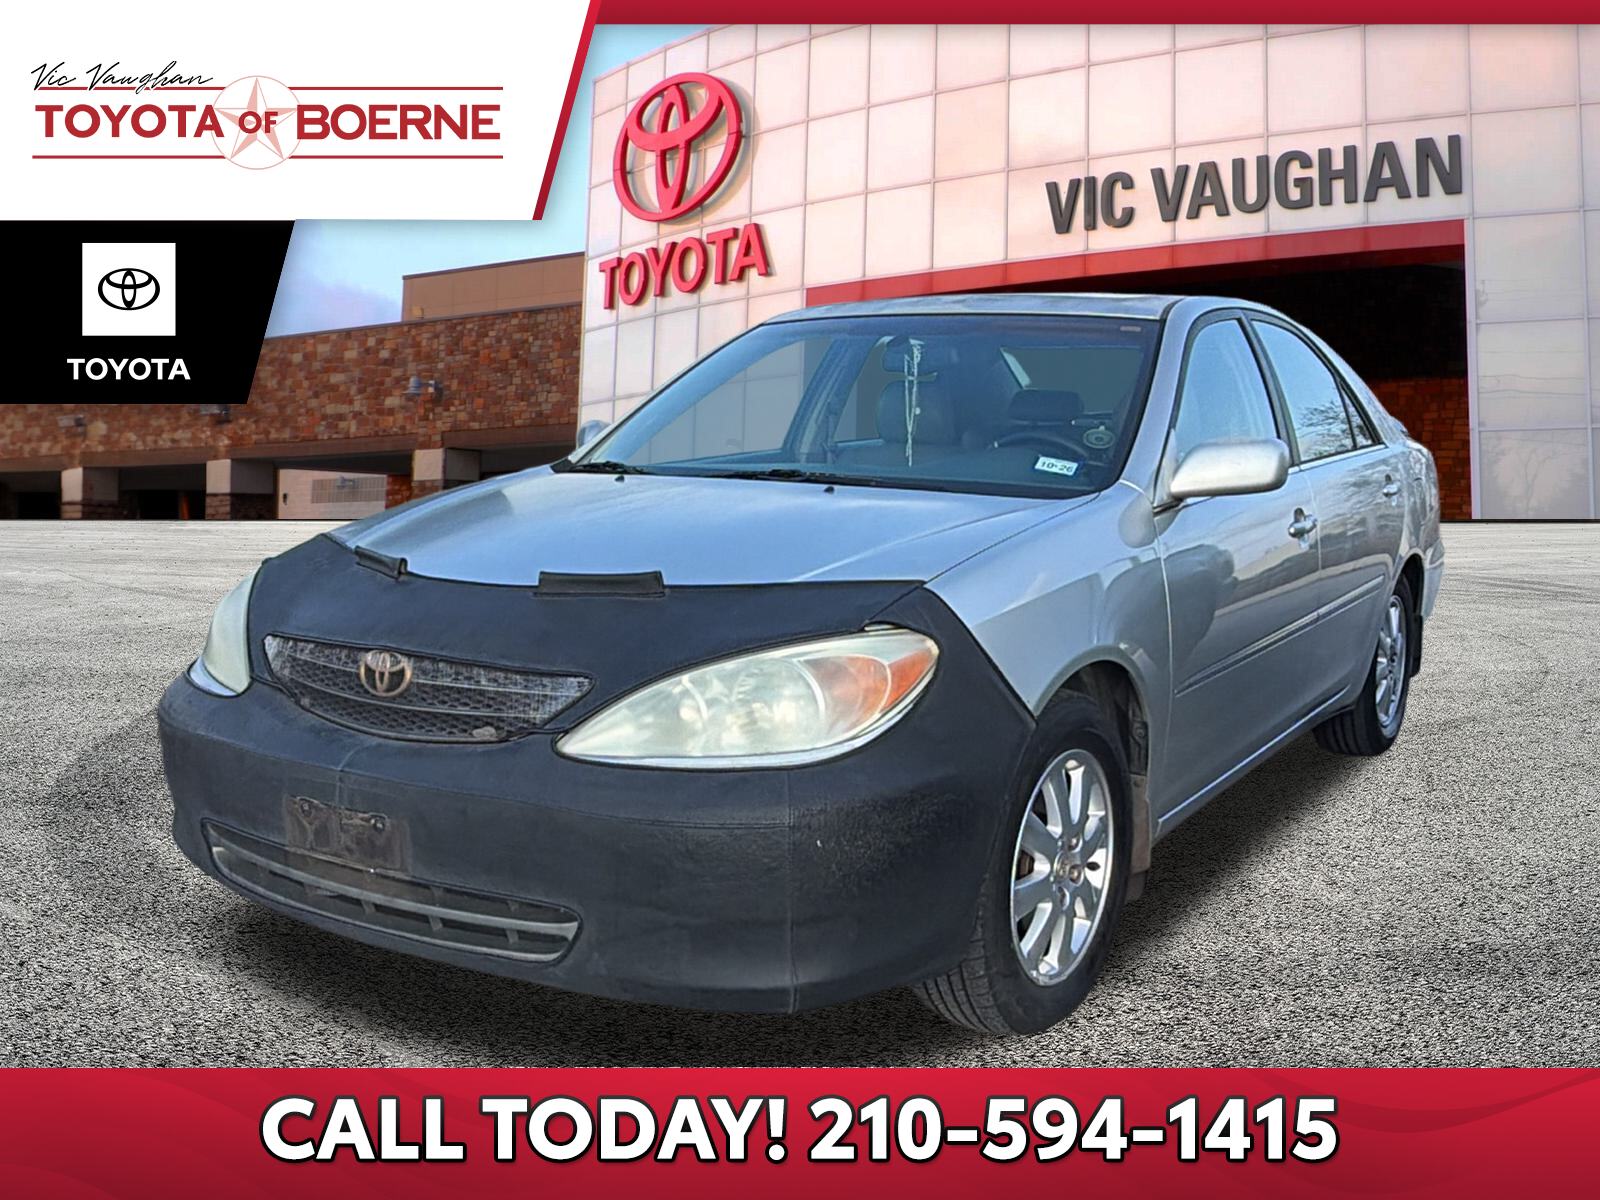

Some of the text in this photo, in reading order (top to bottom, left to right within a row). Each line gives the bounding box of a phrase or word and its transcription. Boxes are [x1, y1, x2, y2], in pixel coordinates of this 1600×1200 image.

[1045, 134, 1463, 234] VIC VAUGHAN
[599, 222, 769, 310] TOYOTA
